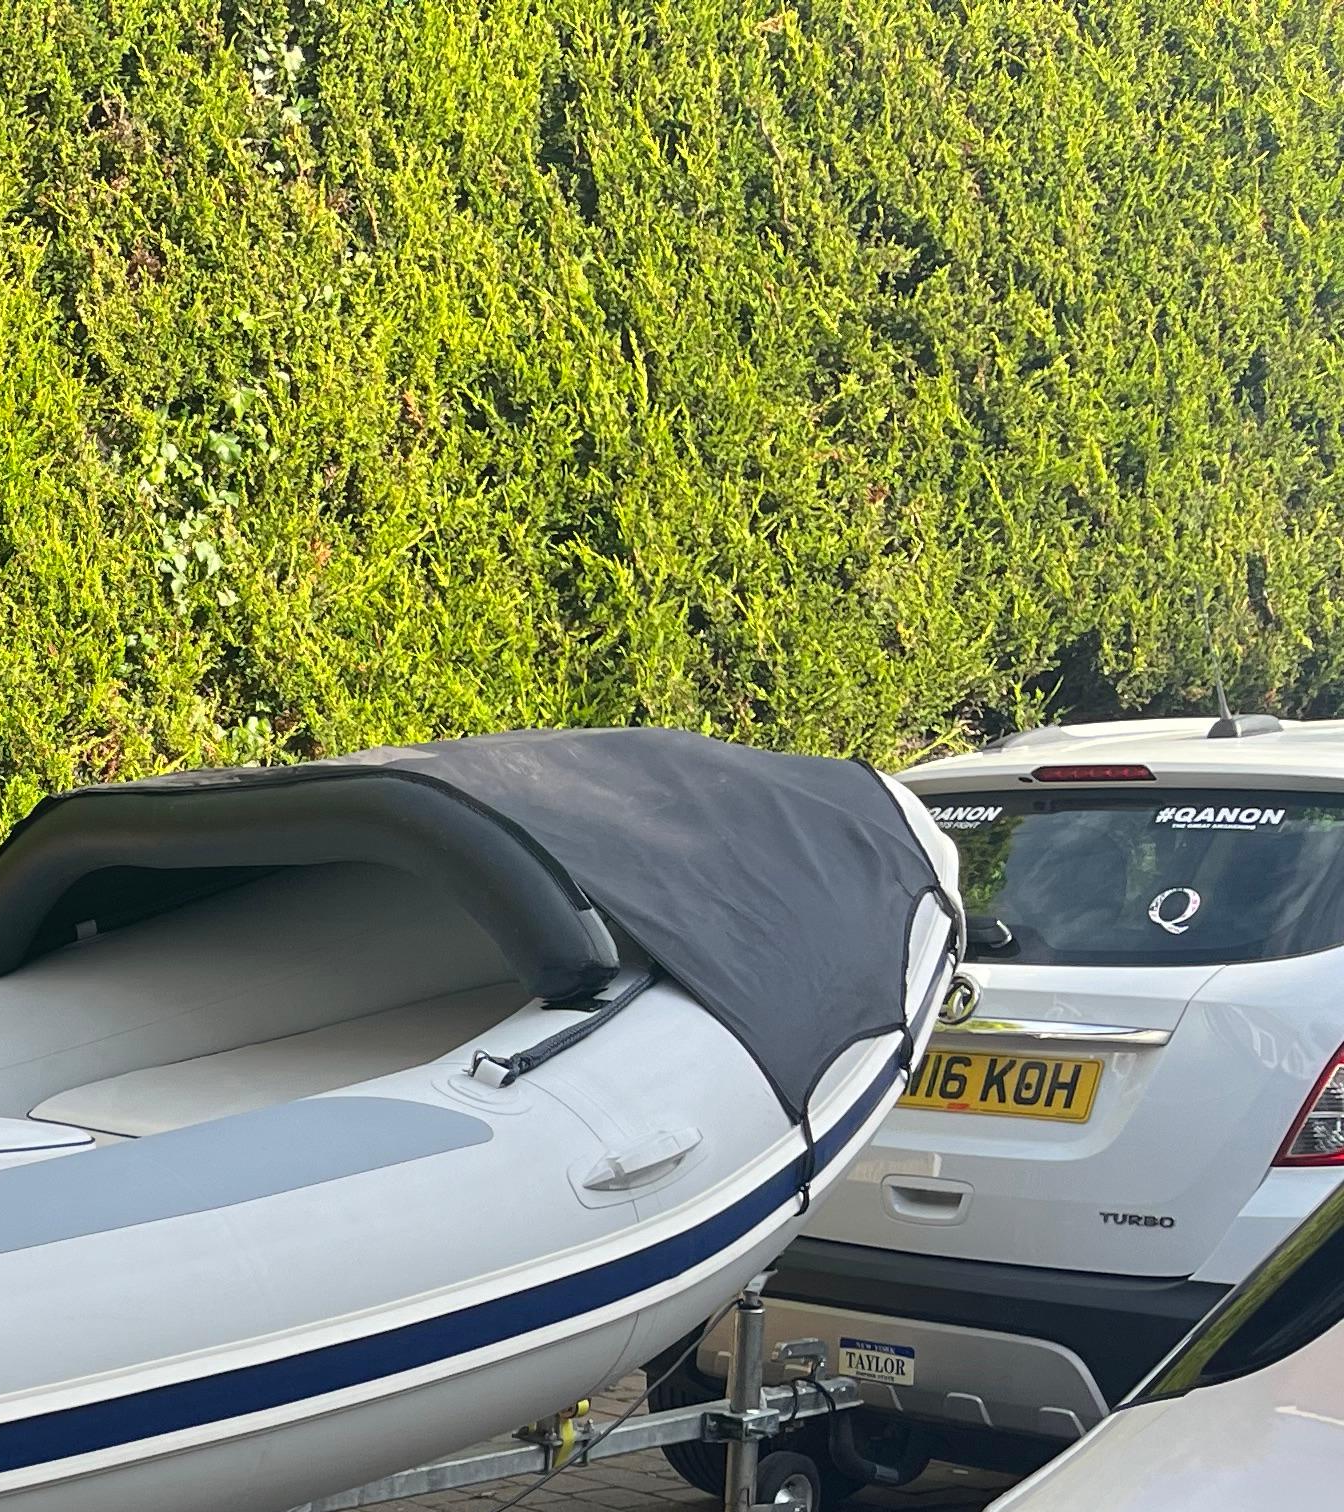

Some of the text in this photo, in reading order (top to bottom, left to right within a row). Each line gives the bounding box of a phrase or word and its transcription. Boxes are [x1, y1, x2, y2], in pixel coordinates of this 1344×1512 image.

[1155, 807, 1285, 824] #QANON
[1148, 887, 1201, 935] Q
[979, 1058, 1082, 1110] KOH
[1099, 1212, 1175, 1228] TURBO
[845, 1351, 906, 1376] TAYLOR
